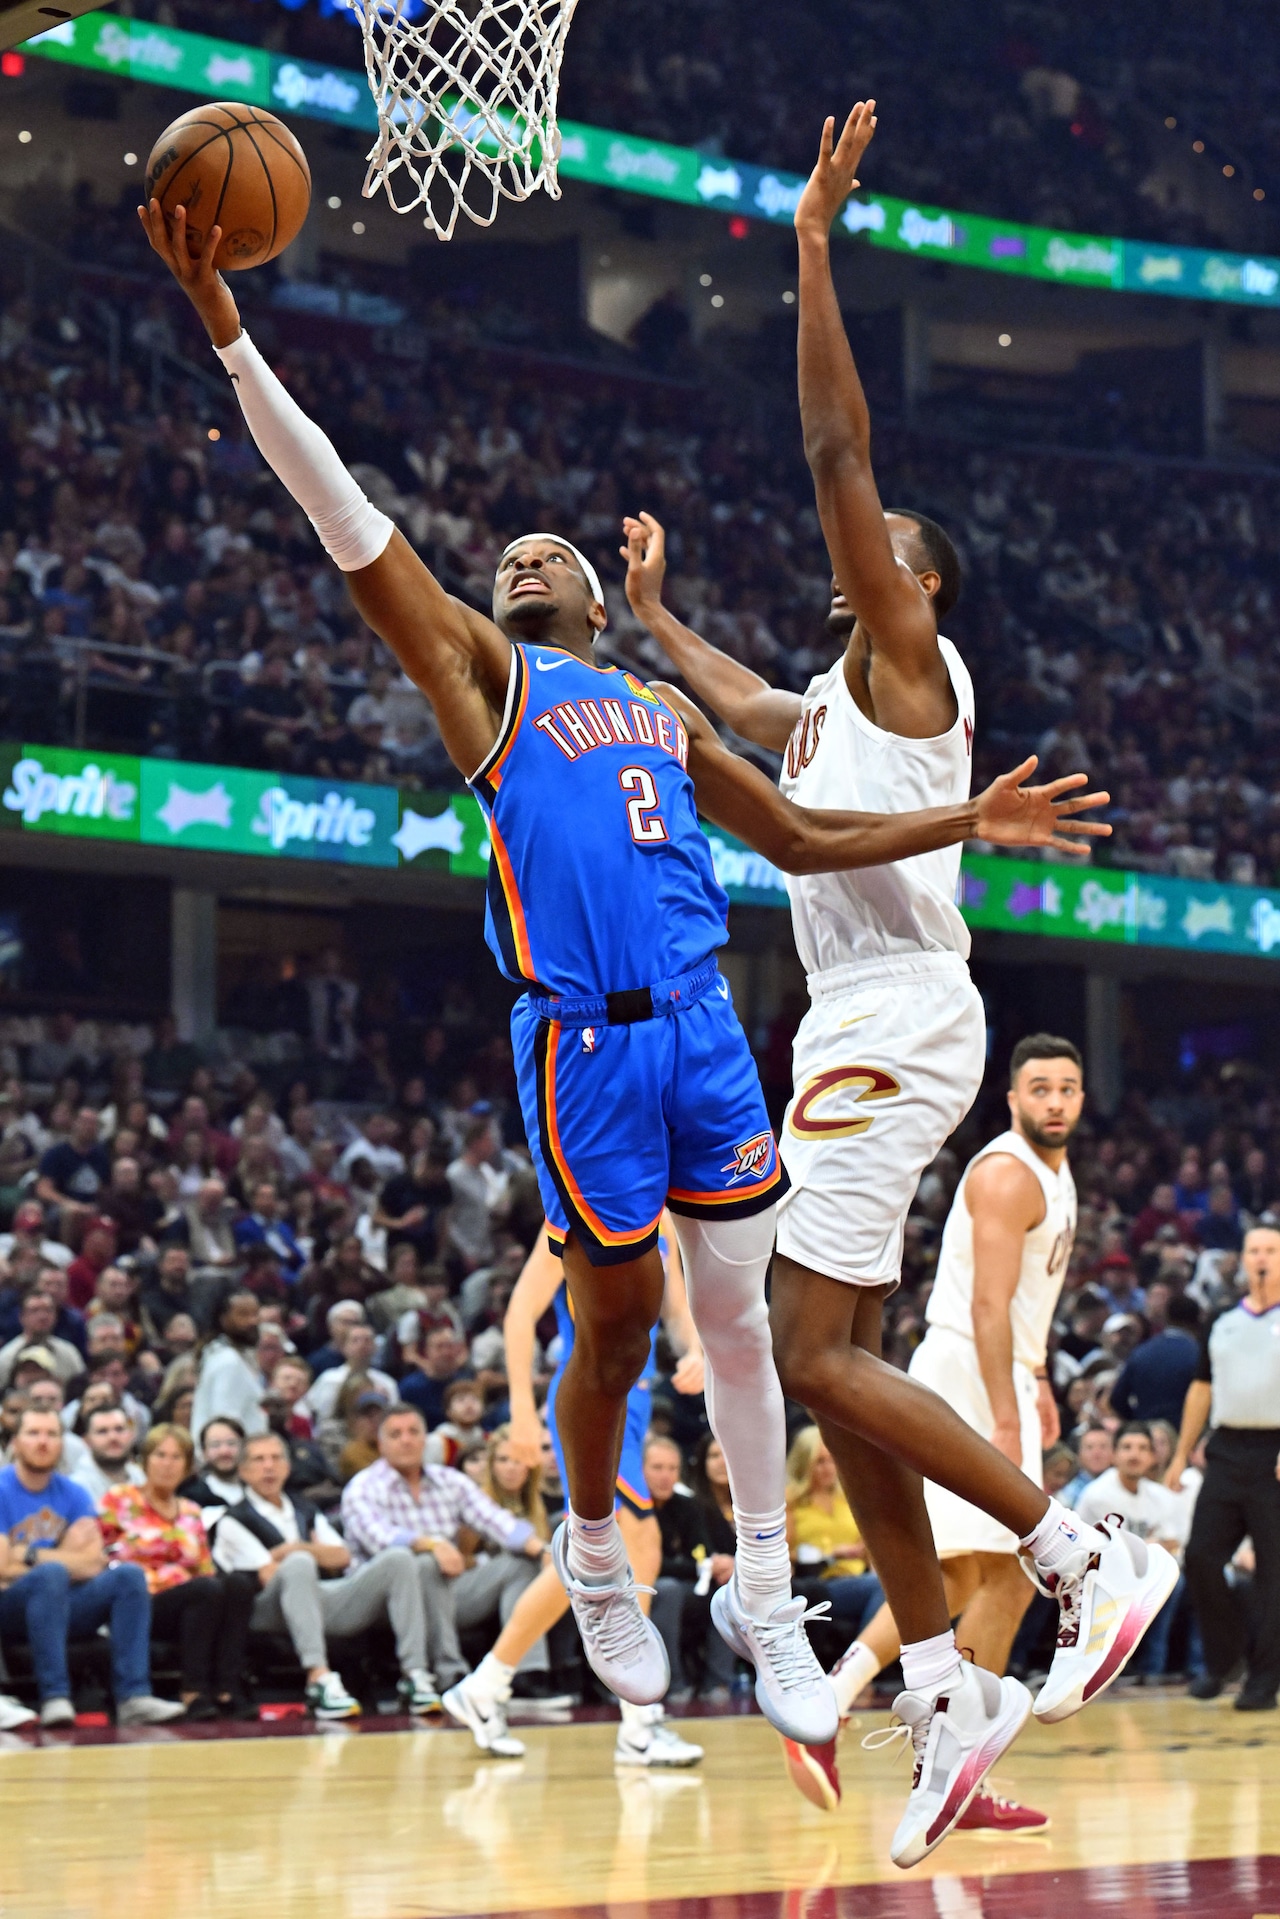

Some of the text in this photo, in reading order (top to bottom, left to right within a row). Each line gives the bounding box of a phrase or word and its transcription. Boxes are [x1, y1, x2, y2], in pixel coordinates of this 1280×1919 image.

[533, 698, 688, 773] THUNDER
[2, 758, 136, 822] Sprite
[252, 786, 376, 849] Sprite
[618, 765, 669, 843] 2
[738, 1140, 768, 1174] OKC
